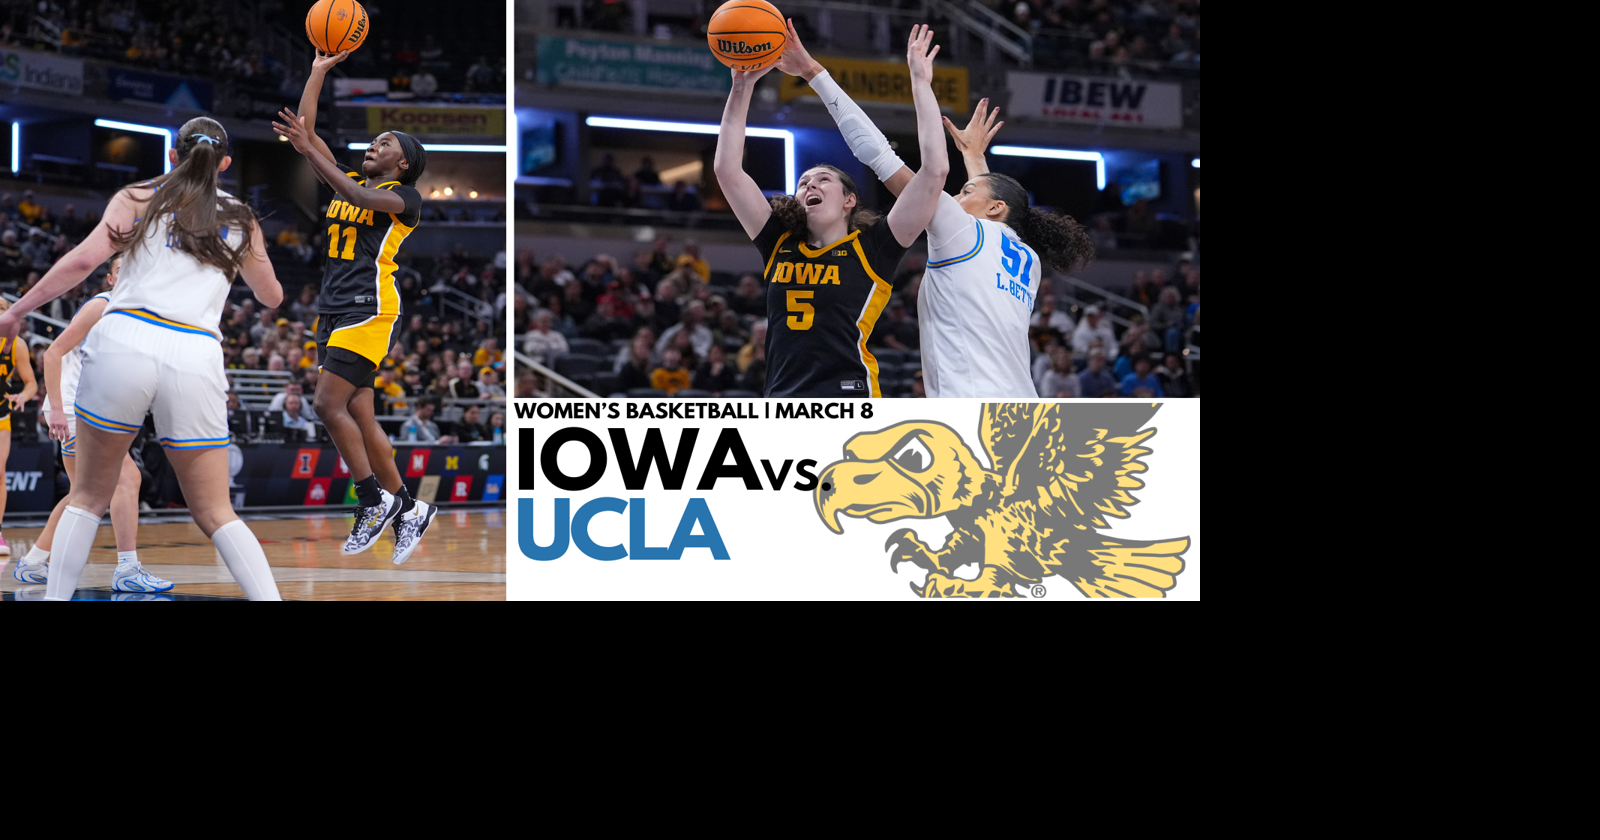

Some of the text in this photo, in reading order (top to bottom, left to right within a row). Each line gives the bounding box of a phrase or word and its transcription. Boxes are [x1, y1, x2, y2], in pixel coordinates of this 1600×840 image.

[717, 38, 772, 54] Wilson
[1044, 78, 1146, 110] IBEW
[380, 107, 488, 126] Koorsen
[326, 199, 374, 226] IOWA
[327, 223, 357, 260] 11
[771, 262, 840, 285] IOWA
[1001, 231, 1032, 287] 51
[786, 290, 815, 330] 5
